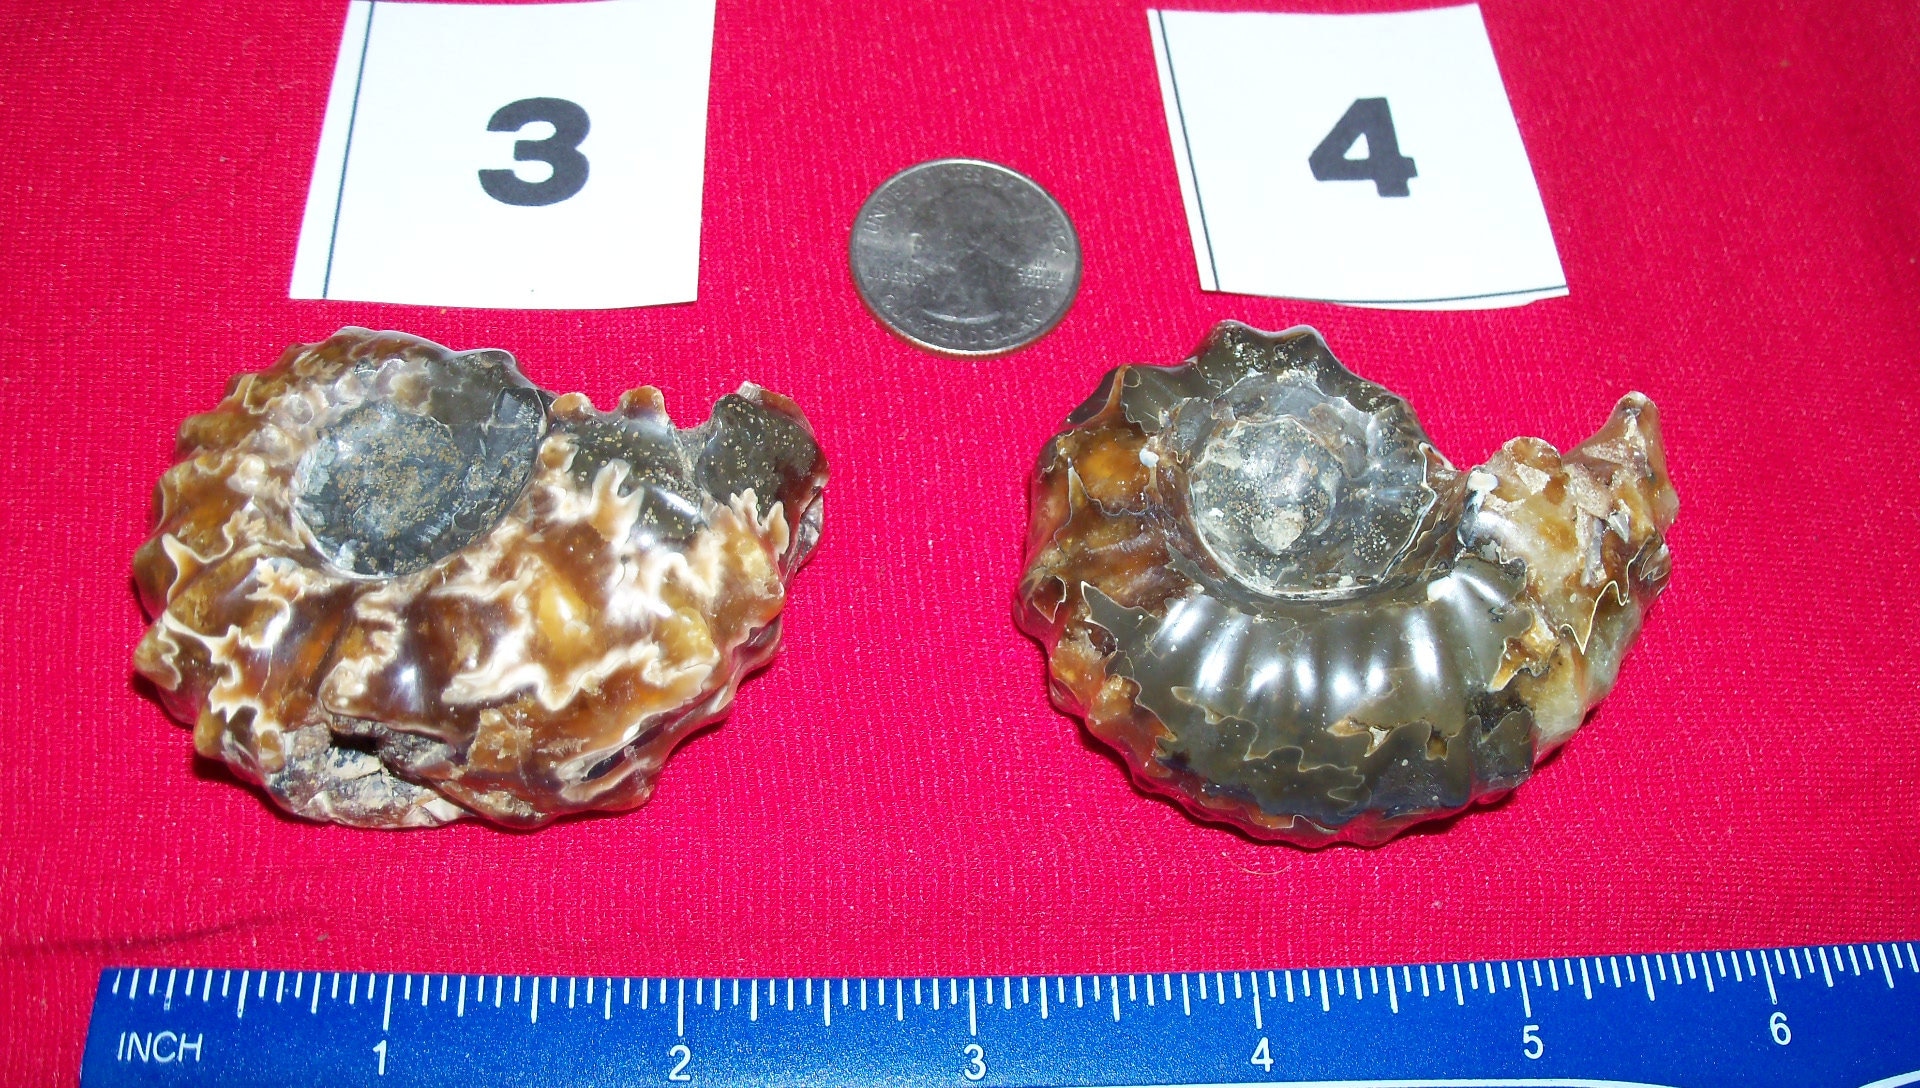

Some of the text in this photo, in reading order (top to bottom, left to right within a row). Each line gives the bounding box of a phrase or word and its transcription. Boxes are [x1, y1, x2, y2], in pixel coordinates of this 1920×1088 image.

[479, 98, 587, 205] 3
[1309, 98, 1416, 196] 4
[118, 1012, 1791, 1081] INCH 1 2 3 4 5 6
